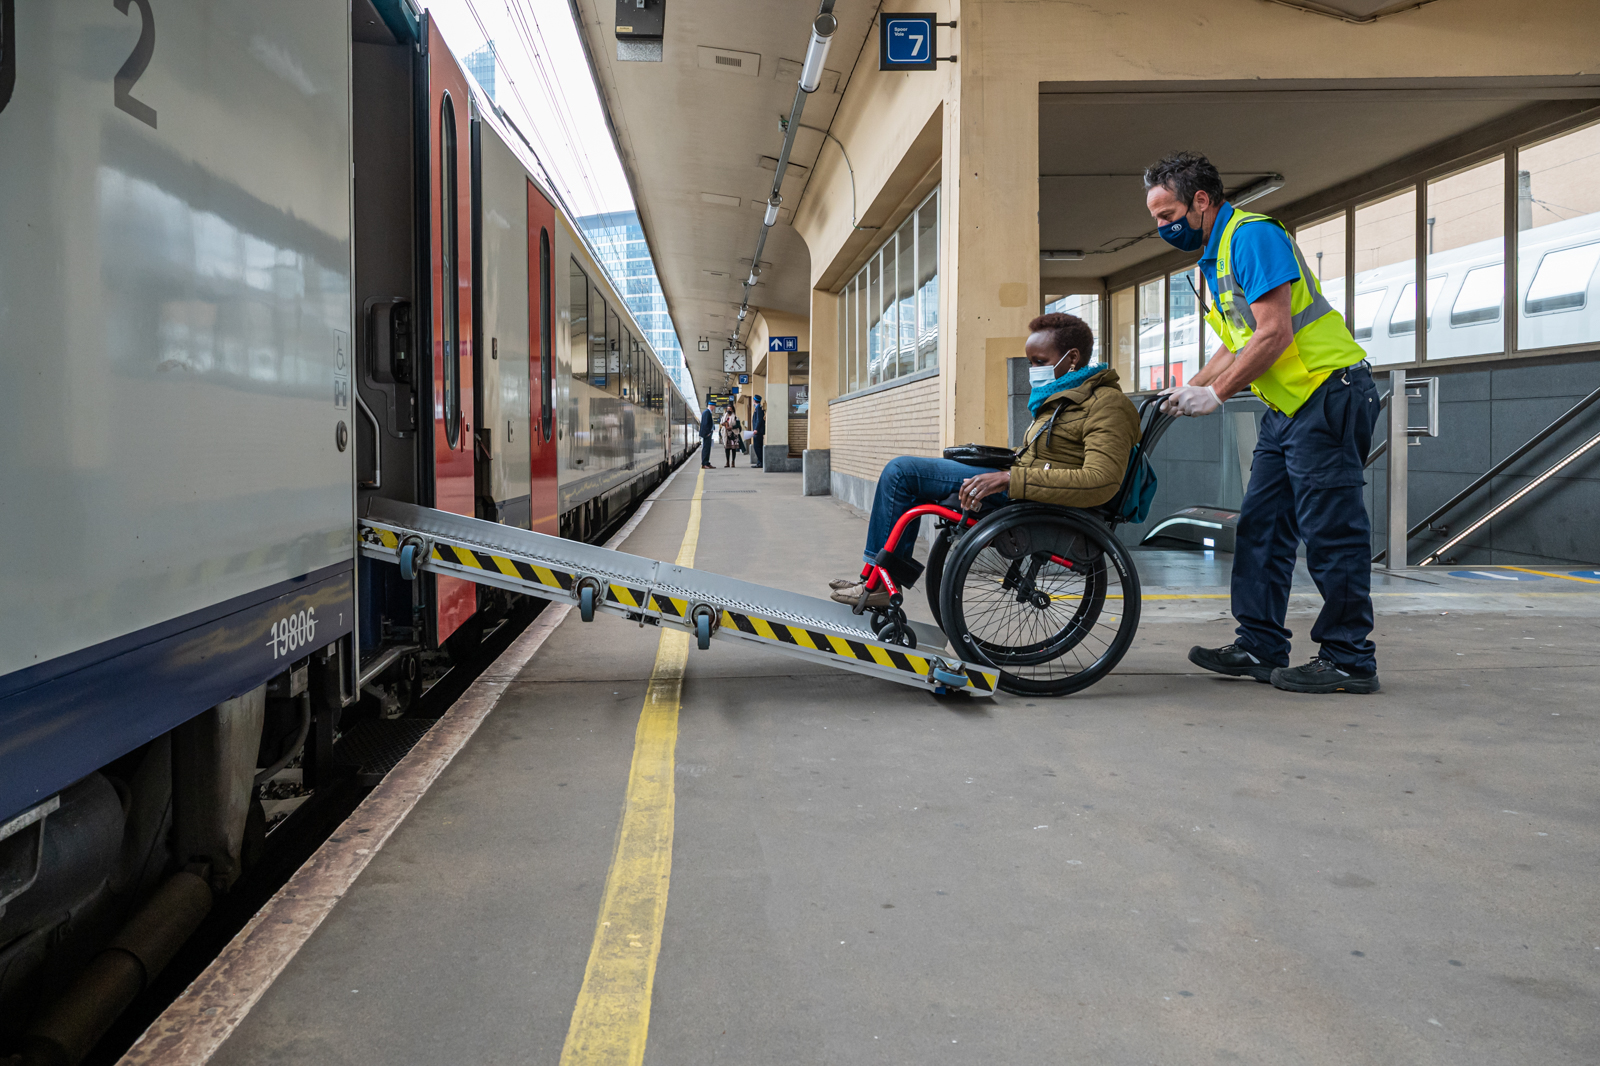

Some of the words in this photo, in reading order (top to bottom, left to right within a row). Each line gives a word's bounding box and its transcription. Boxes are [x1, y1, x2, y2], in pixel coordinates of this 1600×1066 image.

[908, 35, 924, 56] 7
[113, 0, 157, 130] 2
[270, 606, 315, 660] 19806
[339, 613, 343, 626] 7
